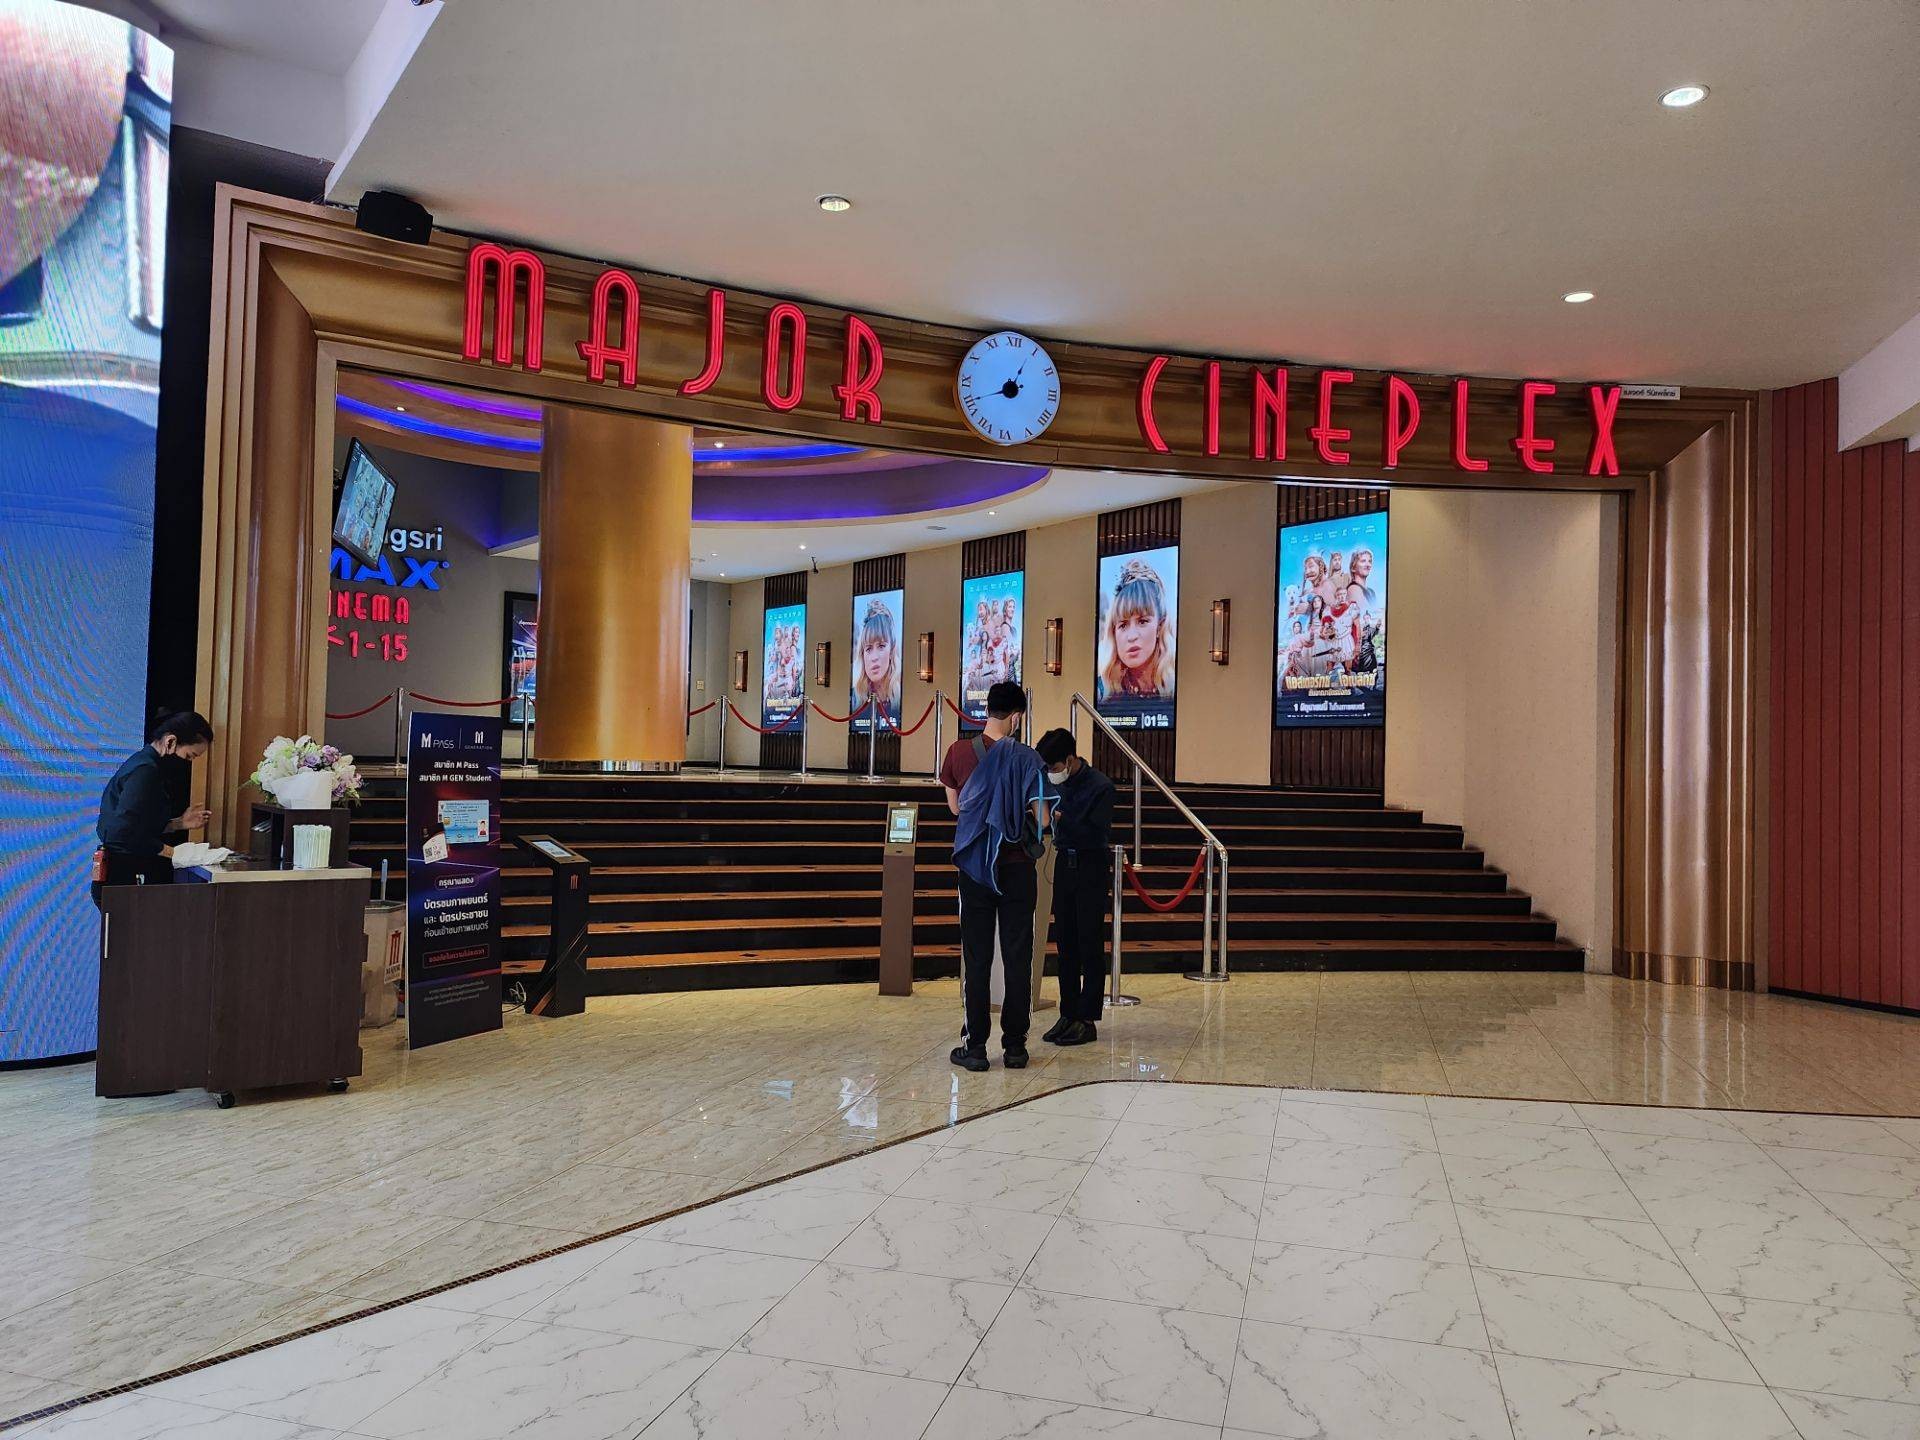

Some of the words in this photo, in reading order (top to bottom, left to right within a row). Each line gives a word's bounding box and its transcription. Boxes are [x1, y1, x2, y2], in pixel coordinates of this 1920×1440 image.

[463, 242, 884, 424] MAJOR
[1136, 355, 1622, 477] CINEPLEX
[421, 732, 432, 748] M
[433, 739, 455, 749] PASS
[475, 731, 484, 744] M
[456, 761, 463, 769] M
[464, 761, 479, 769] Pass
[442, 774, 448, 782] M
[449, 774, 464, 782] GEN
[465, 774, 492, 782] Student
